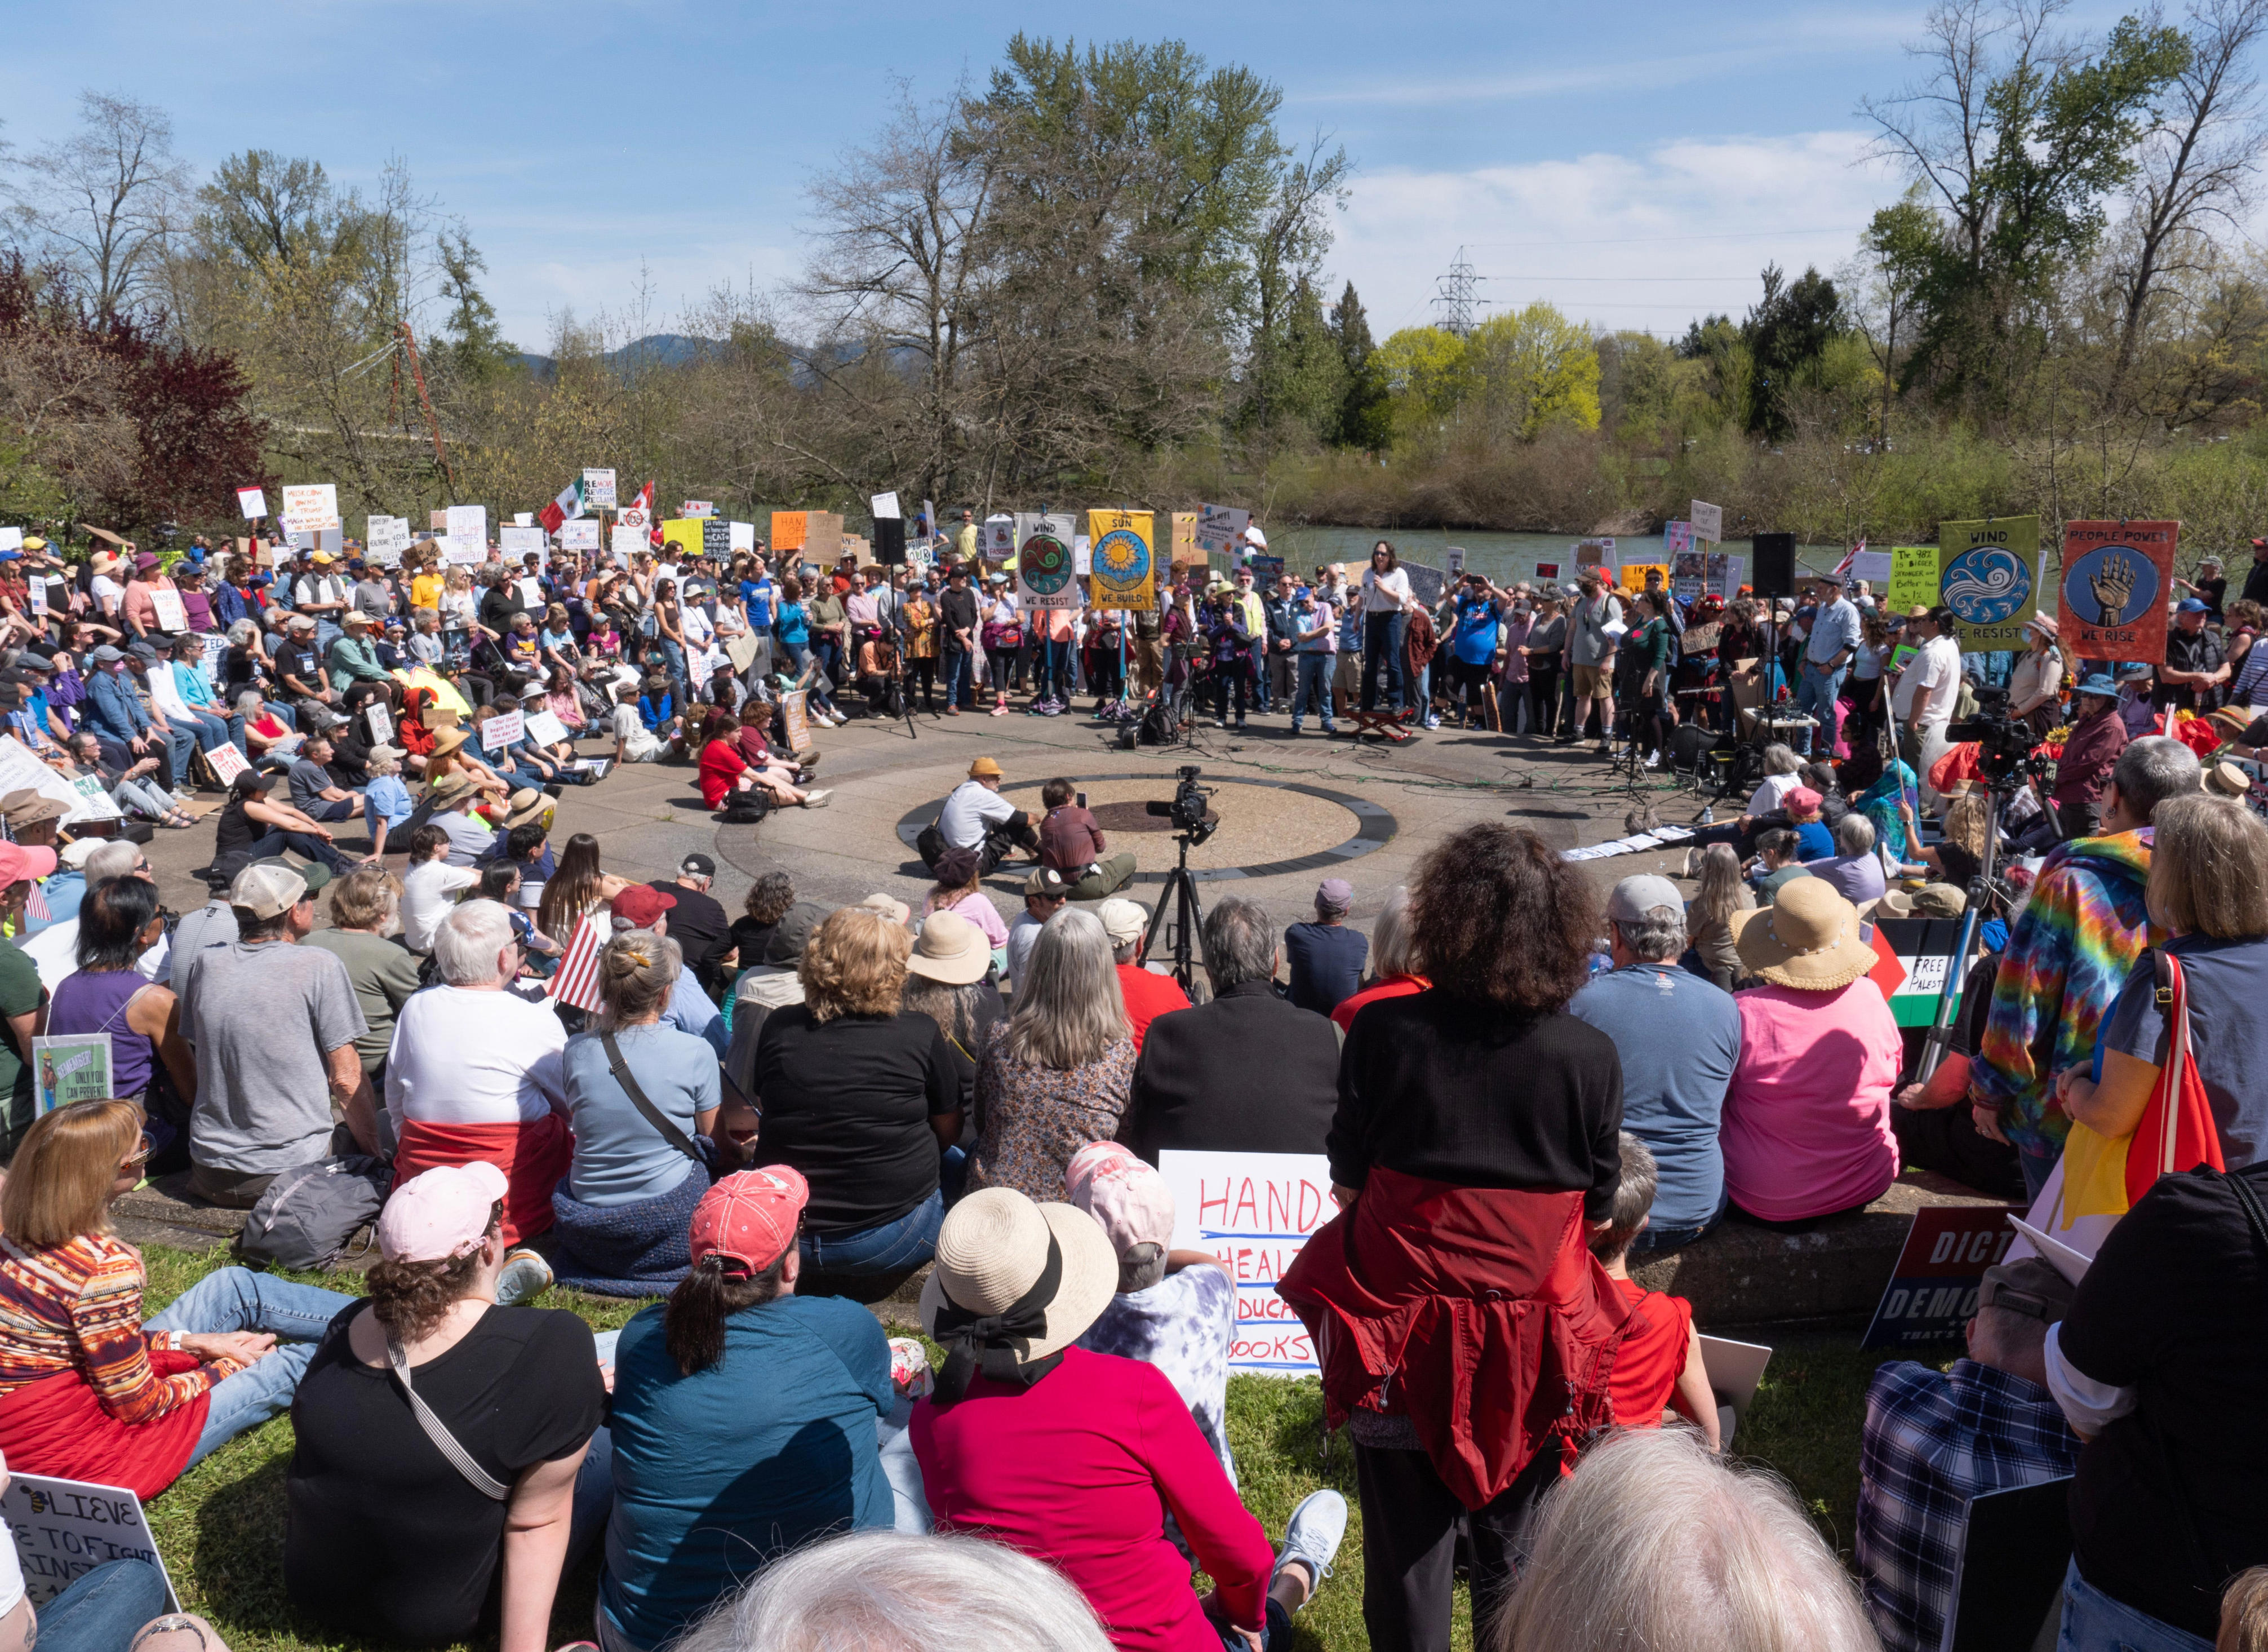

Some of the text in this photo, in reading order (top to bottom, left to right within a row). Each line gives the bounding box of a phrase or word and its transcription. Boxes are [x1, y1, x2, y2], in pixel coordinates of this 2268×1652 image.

[623, 513, 648, 524] MUSK
[1112, 519, 1132, 528] SUN
[451, 526, 483, 537] TRUMP
[1033, 523, 1056, 533] WIND
[1206, 524, 1235, 533] DEMOCRACY
[1970, 531, 2008, 543] WIND
[2070, 530, 2168, 542] PEOPLE POWER
[909, 548, 931, 560] OUR
[1897, 550, 1932, 559] The 98%
[1896, 579, 1921, 588] Better
[1025, 596, 1069, 606] WE RESIST
[1101, 594, 1142, 603] WE BUILD
[1955, 627, 2021, 639] E RESIST
[2081, 630, 2136, 643] WE RISE
[486, 739, 506, 747] become
[74, 776, 104, 798] STEAL
[1914, 958, 1944, 974] FREE
[1909, 975, 1947, 992] PALESTI
[75, 1070, 104, 1084] ONLY YOU
[66, 1085, 105, 1099] CAN PREVENT
[1929, 1231, 2014, 1264] DICT
[1215, 1247, 1302, 1283] HEAL
[1881, 1287, 1979, 1319] DEMO
[1901, 1330, 1956, 1340] THAT'S
